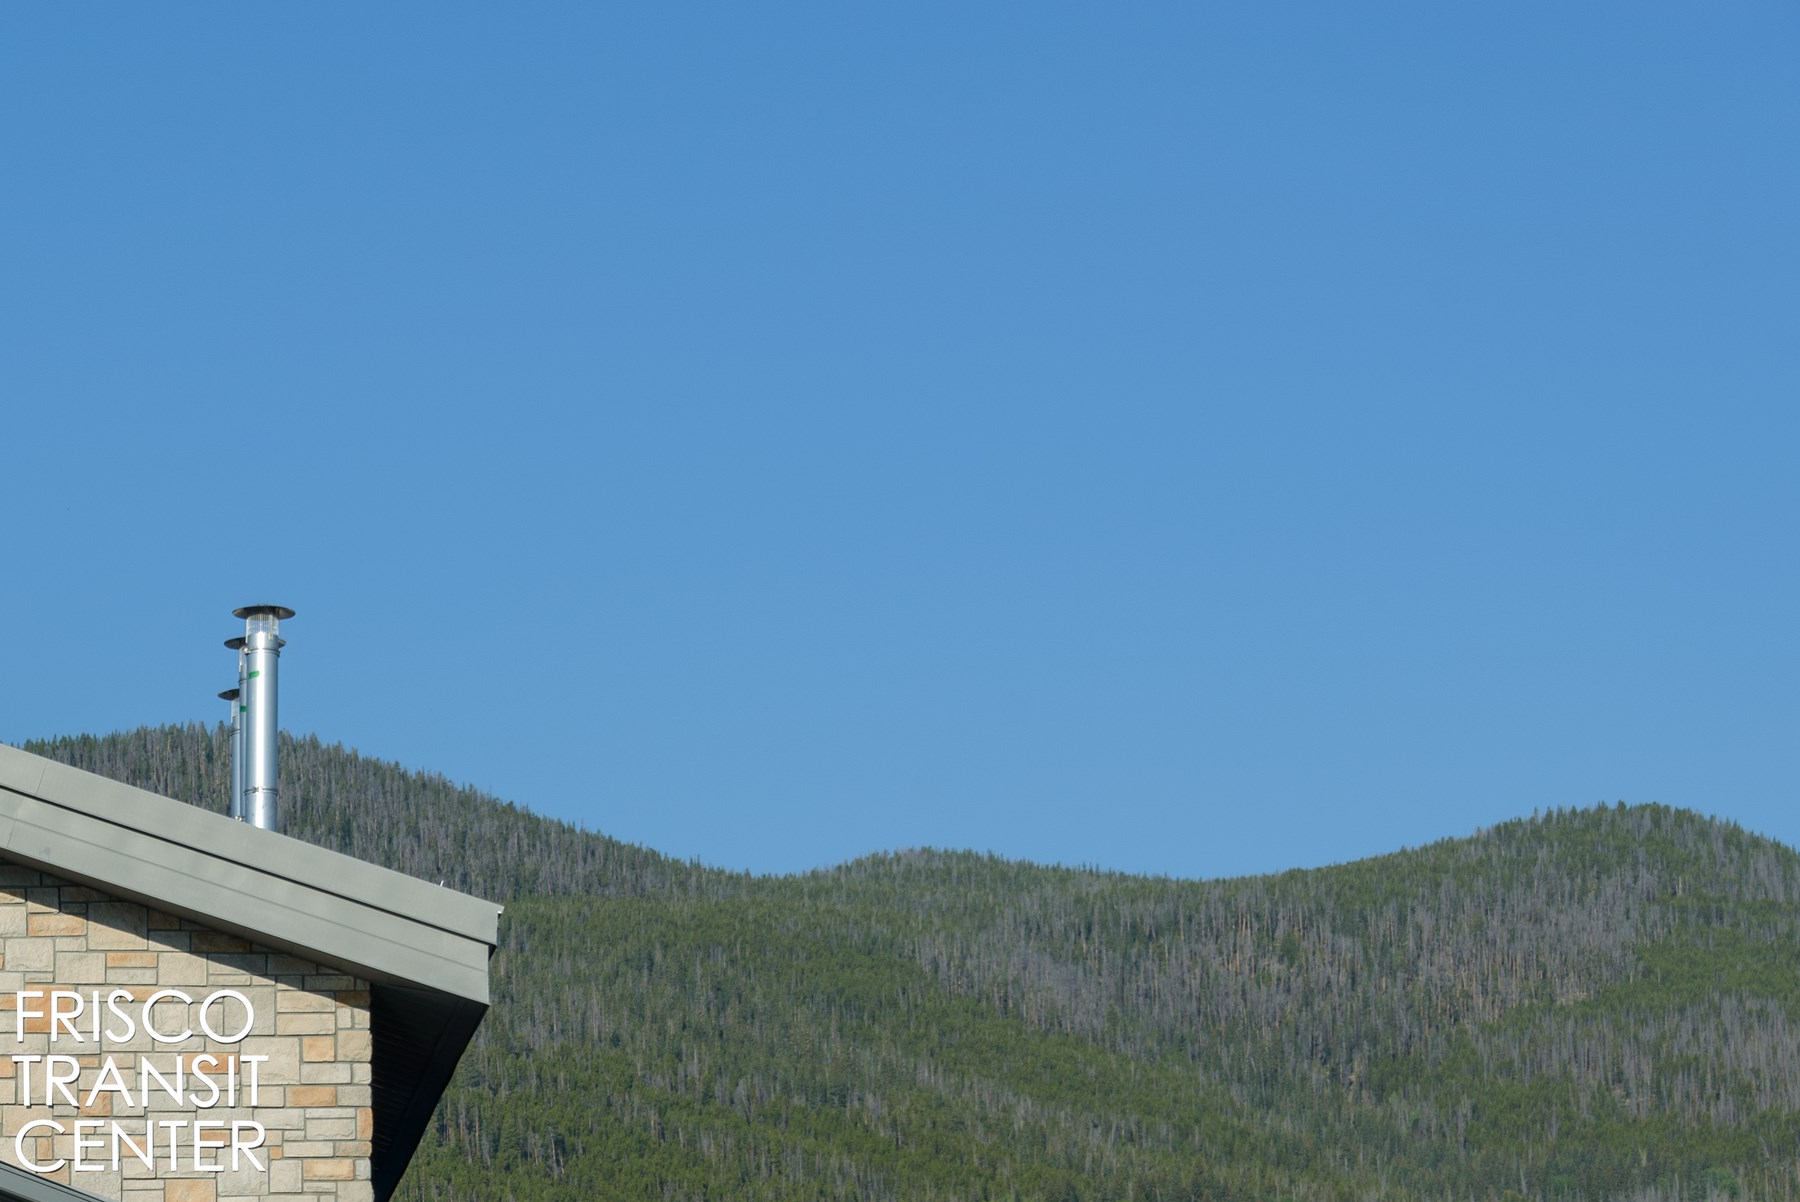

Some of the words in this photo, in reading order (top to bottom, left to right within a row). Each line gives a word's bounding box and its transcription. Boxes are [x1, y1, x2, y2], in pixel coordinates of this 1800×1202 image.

[15, 989, 255, 1044] FRISCO
[11, 1053, 270, 1108] TRANSIT
[14, 1119, 267, 1173] CENTER
